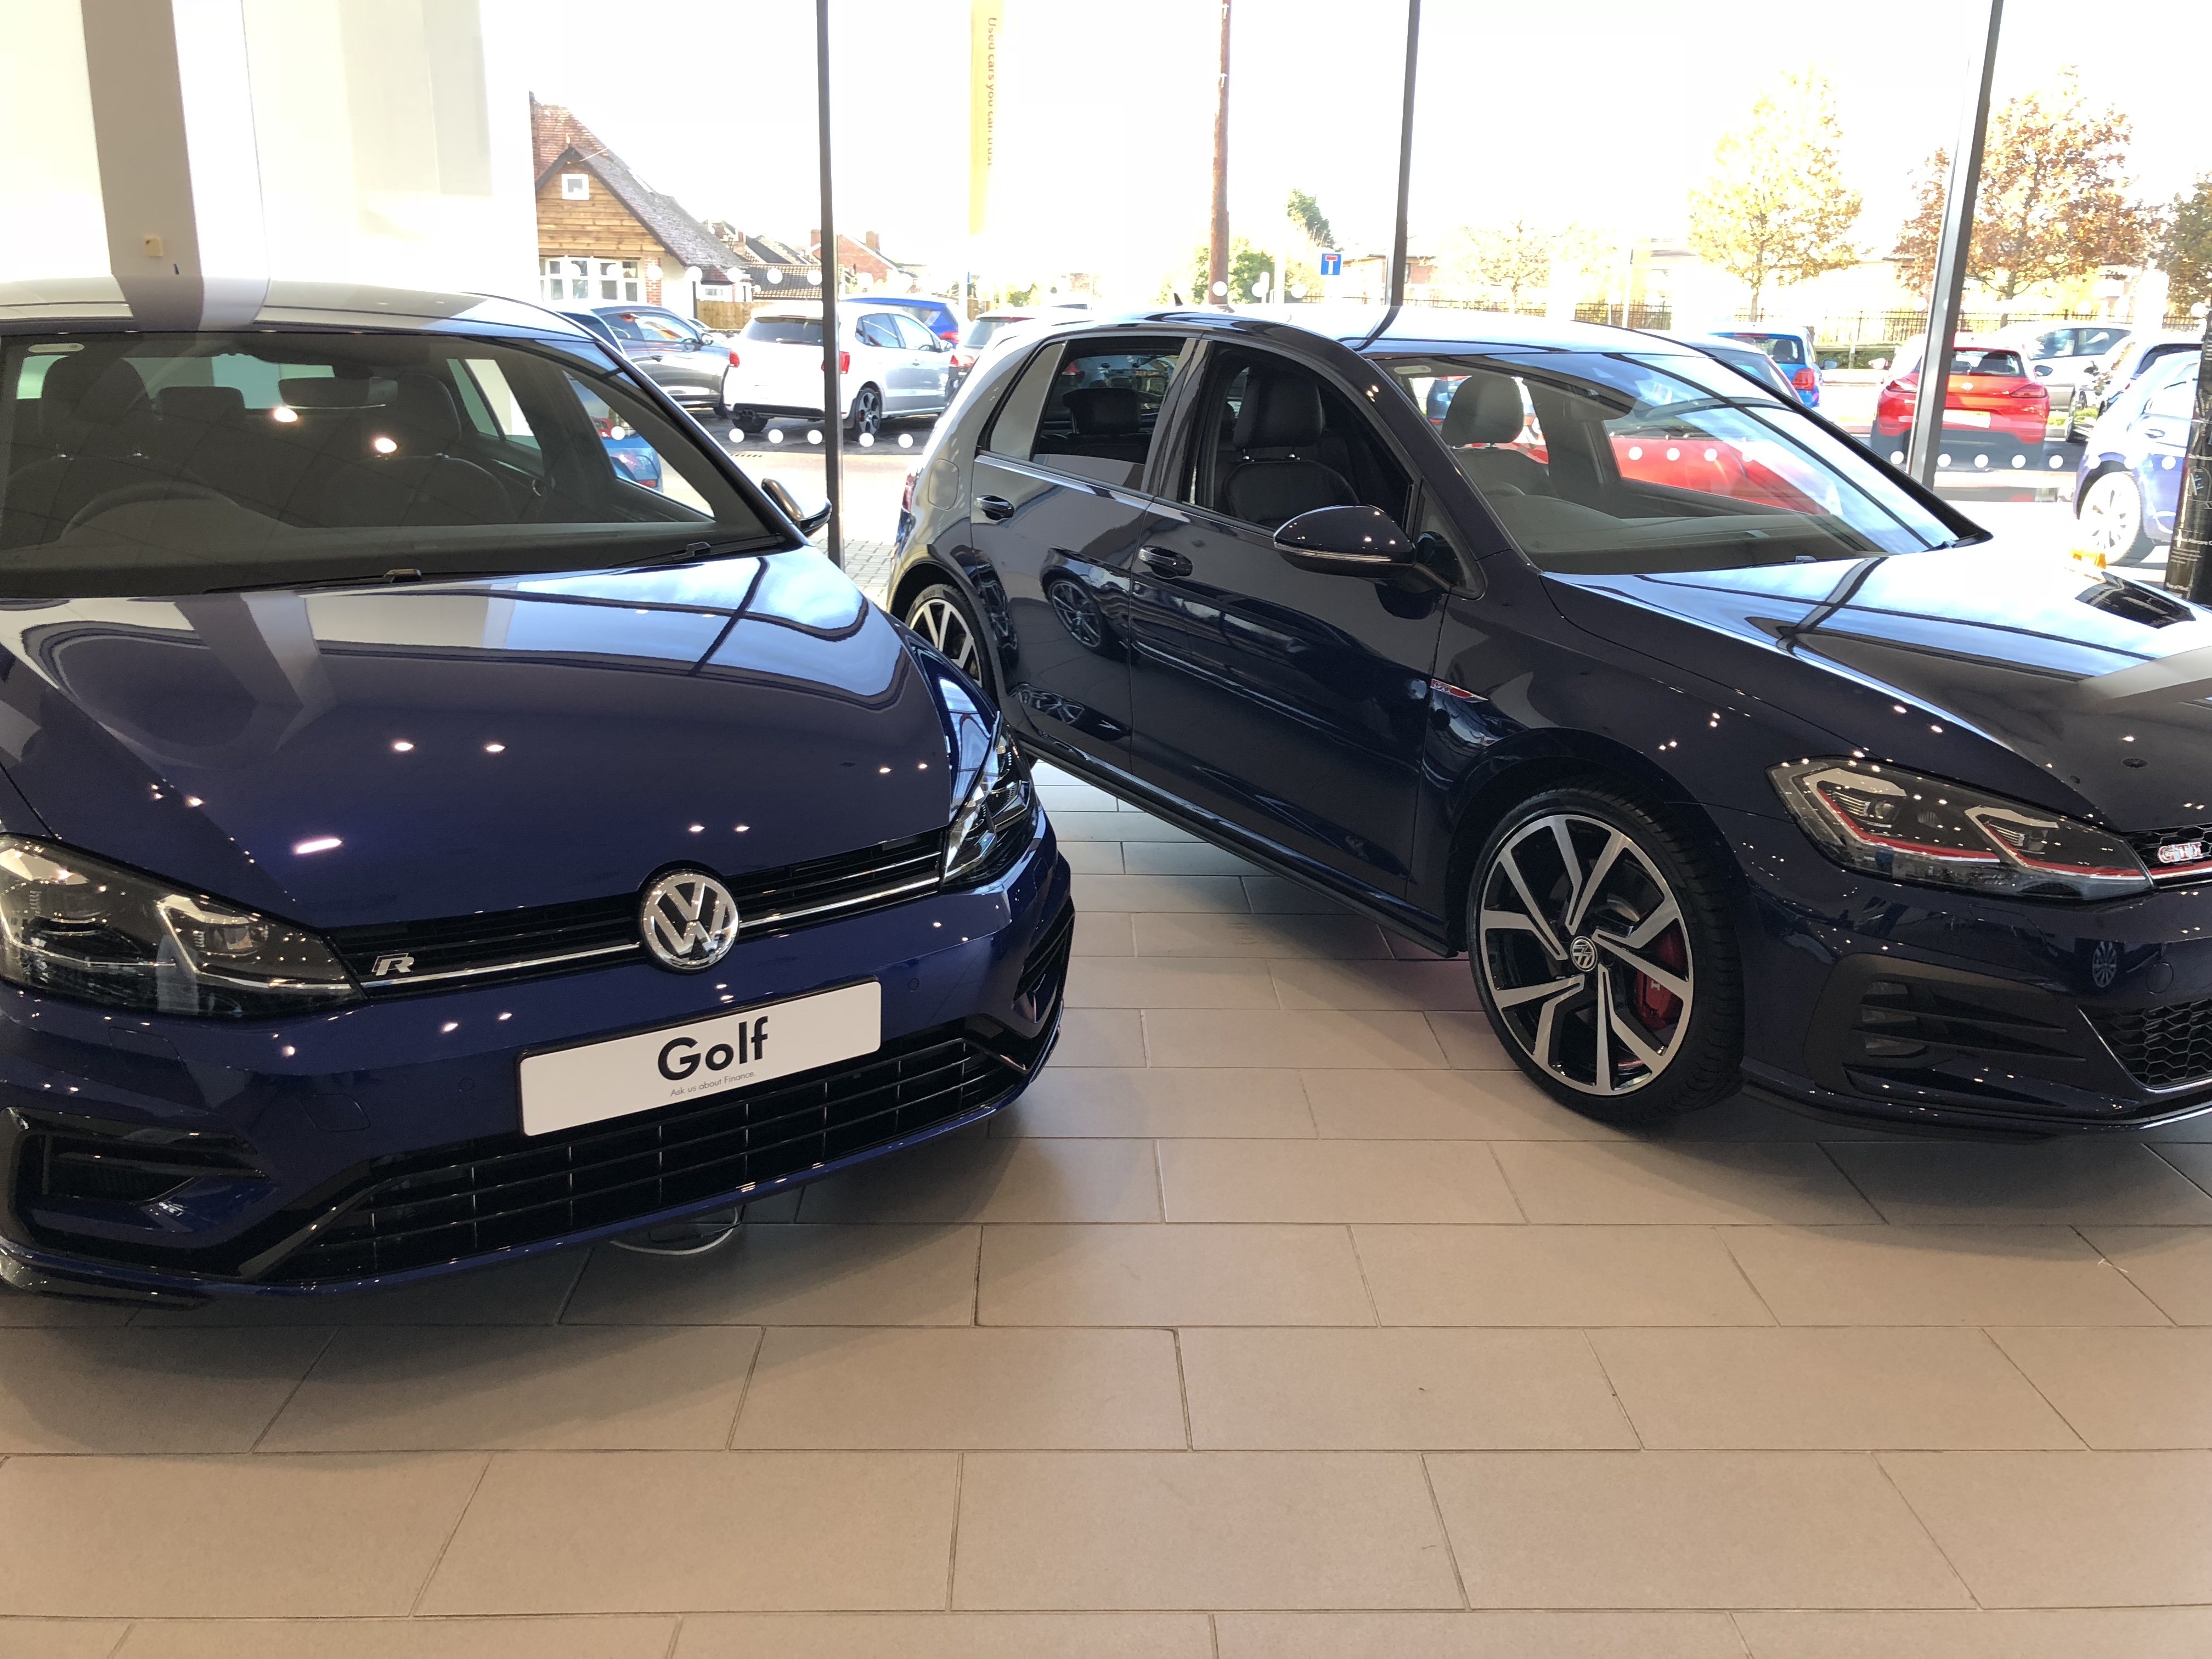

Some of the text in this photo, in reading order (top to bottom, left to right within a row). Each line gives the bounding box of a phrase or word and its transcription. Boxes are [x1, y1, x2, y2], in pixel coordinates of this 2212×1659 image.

[988, 17, 997, 50] Used
[985, 84, 994, 107] you
[2158, 842, 2203, 863] GTI
[372, 952, 415, 976] R
[658, 1016, 768, 1080] Golf
[670, 1087, 685, 1097] Ask
[699, 1079, 722, 1090] about
[724, 1071, 756, 1084] Finance.
